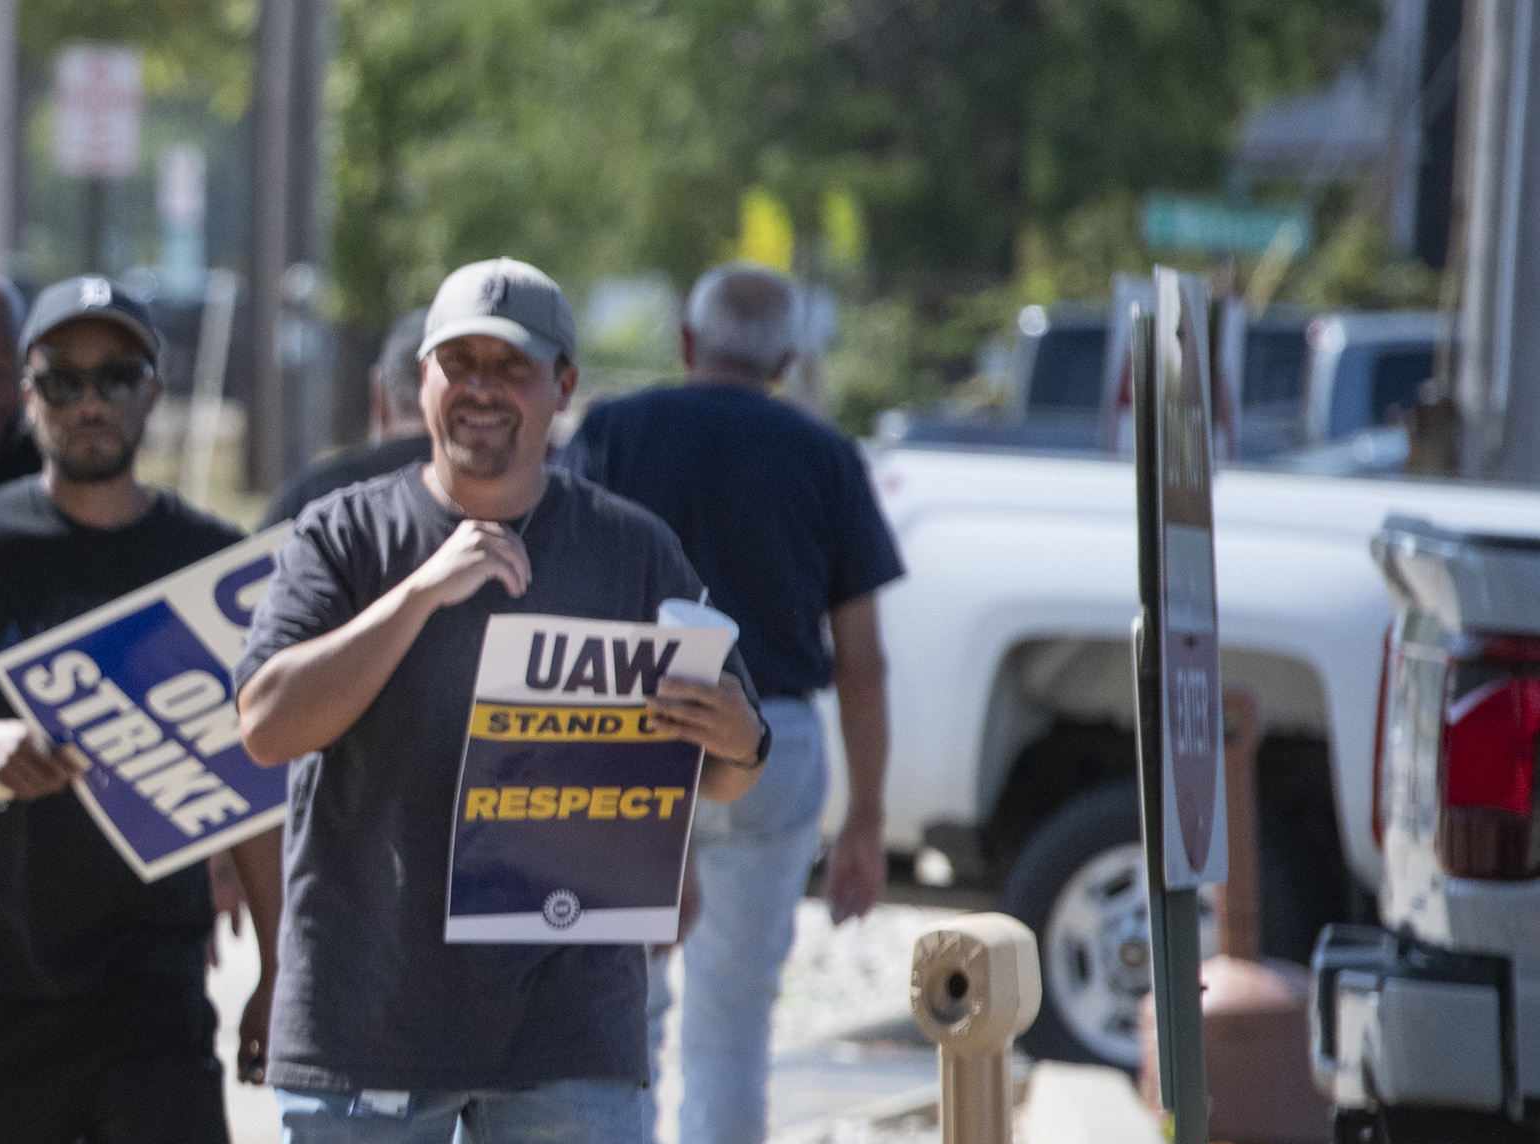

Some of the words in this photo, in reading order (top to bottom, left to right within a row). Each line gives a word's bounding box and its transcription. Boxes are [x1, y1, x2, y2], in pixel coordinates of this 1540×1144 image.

[525, 631, 681, 697] UAW
[23, 650, 251, 838] STRIKE
[146, 669, 240, 758] ON
[489, 713, 623, 735] STAND
[465, 787, 685, 821] RESPECT
